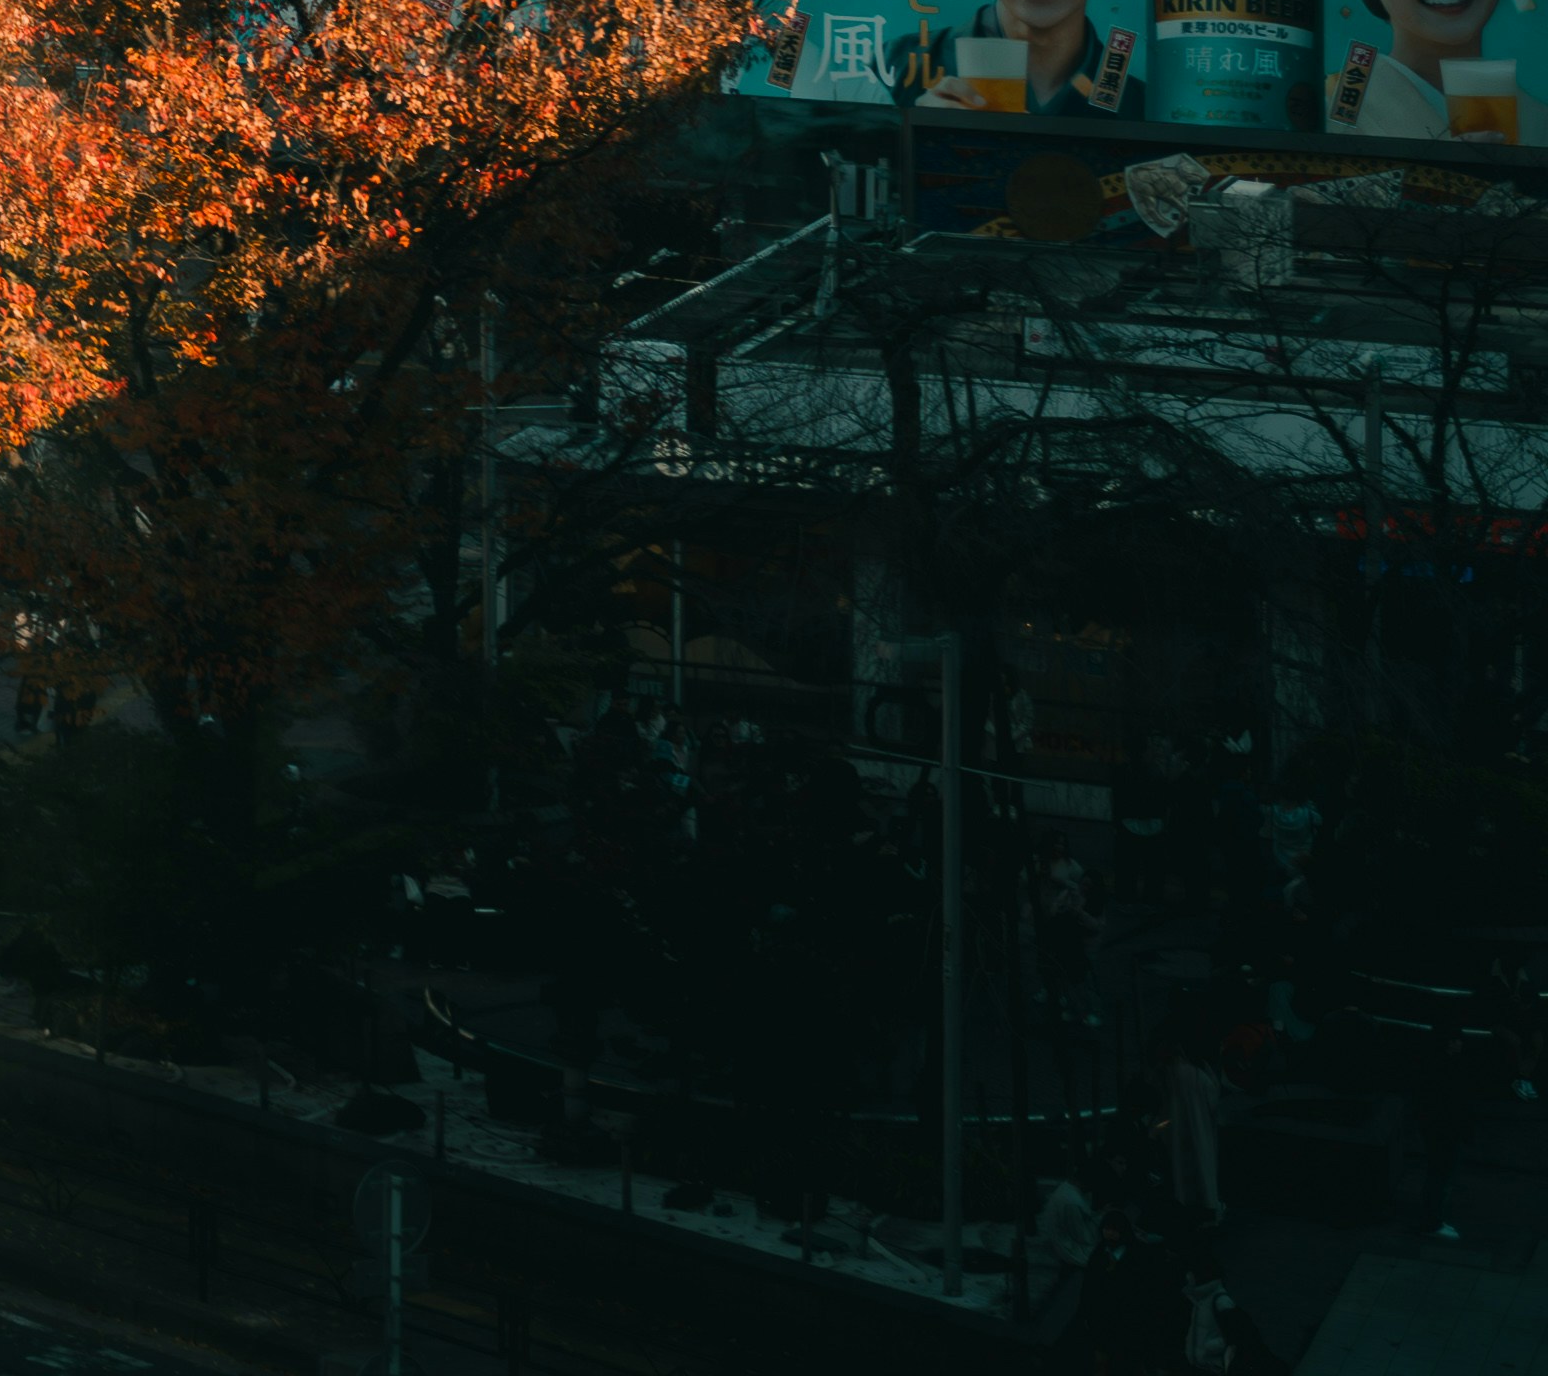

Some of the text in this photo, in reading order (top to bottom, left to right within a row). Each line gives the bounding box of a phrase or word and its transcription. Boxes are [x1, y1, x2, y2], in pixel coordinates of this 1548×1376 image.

[1181, 21, 1288, 43] 麦芽100%ビール
[1186, 48, 1283, 78] 晴れ風
